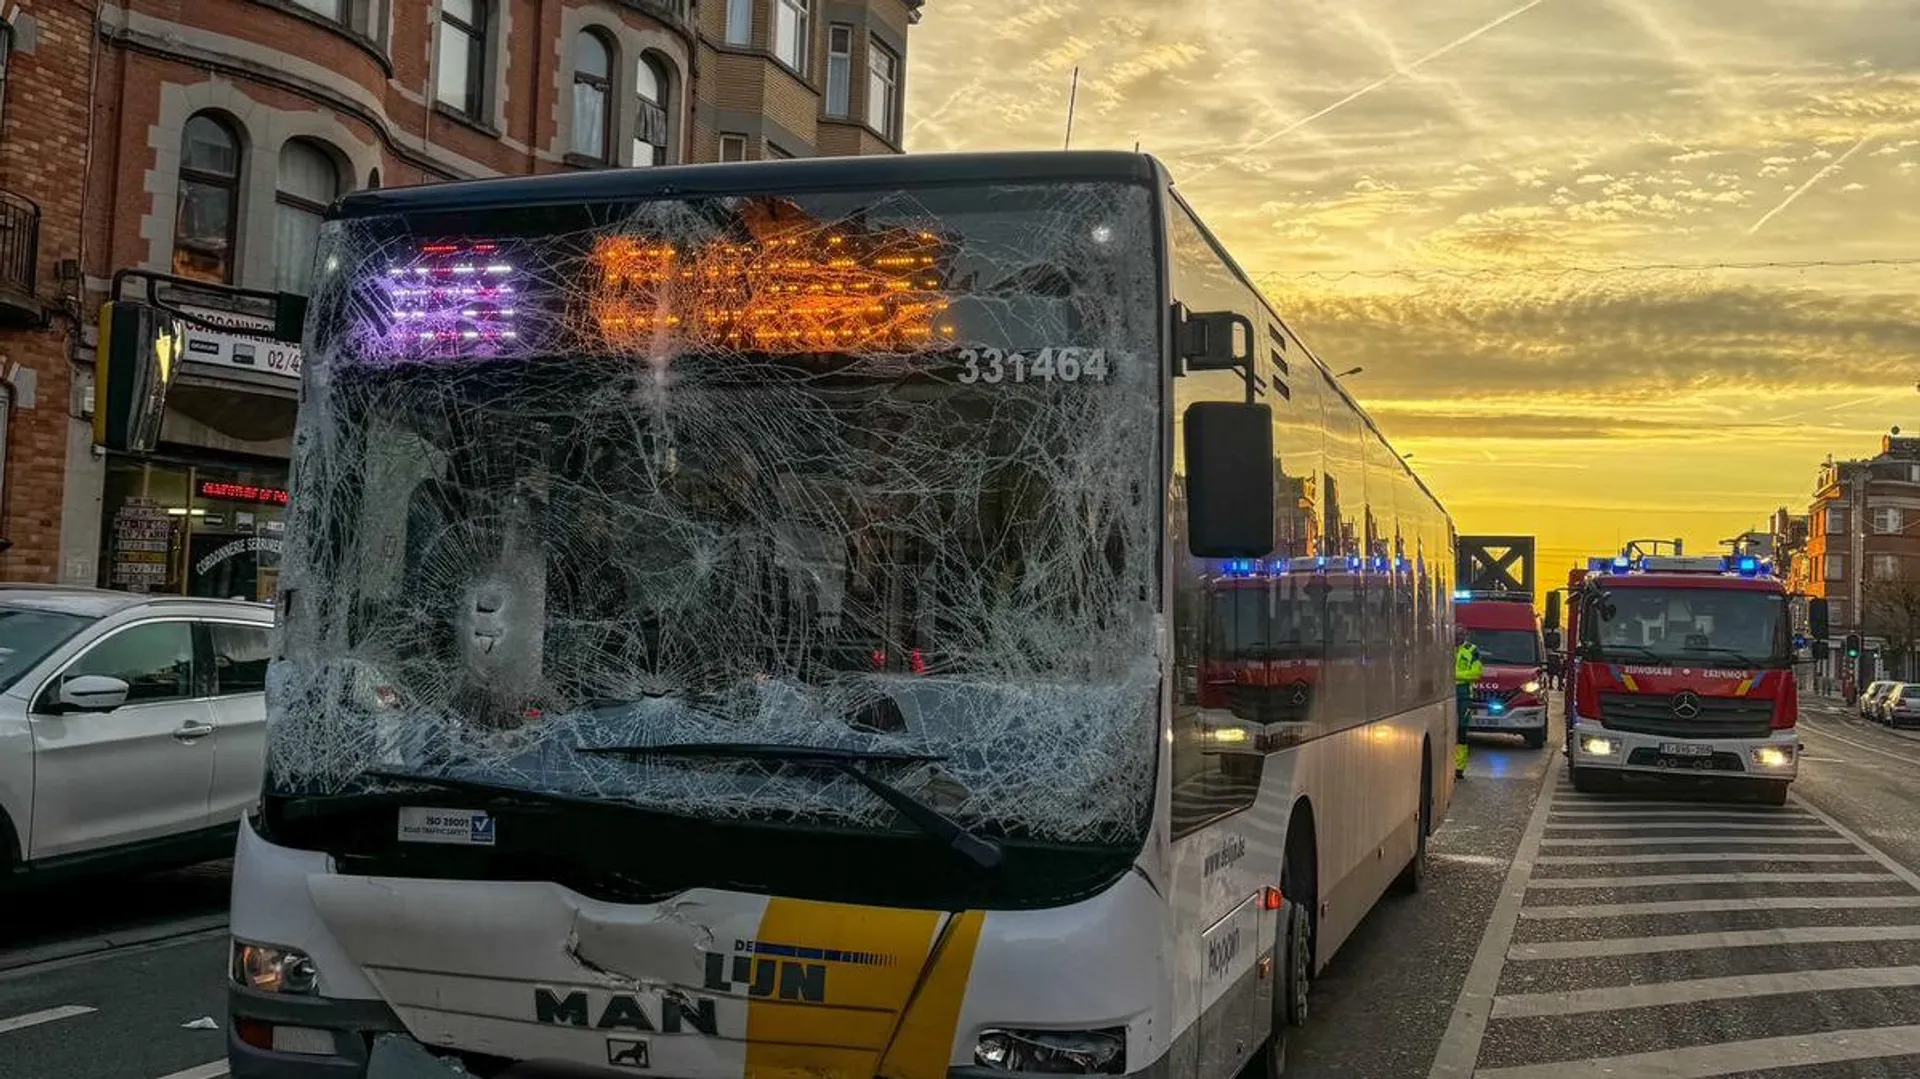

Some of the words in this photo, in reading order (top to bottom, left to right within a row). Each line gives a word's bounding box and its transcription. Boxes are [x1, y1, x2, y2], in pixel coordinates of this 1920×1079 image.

[957, 347, 1108, 384] 331464
[734, 939, 755, 952] DE
[535, 987, 719, 1037] MAN
